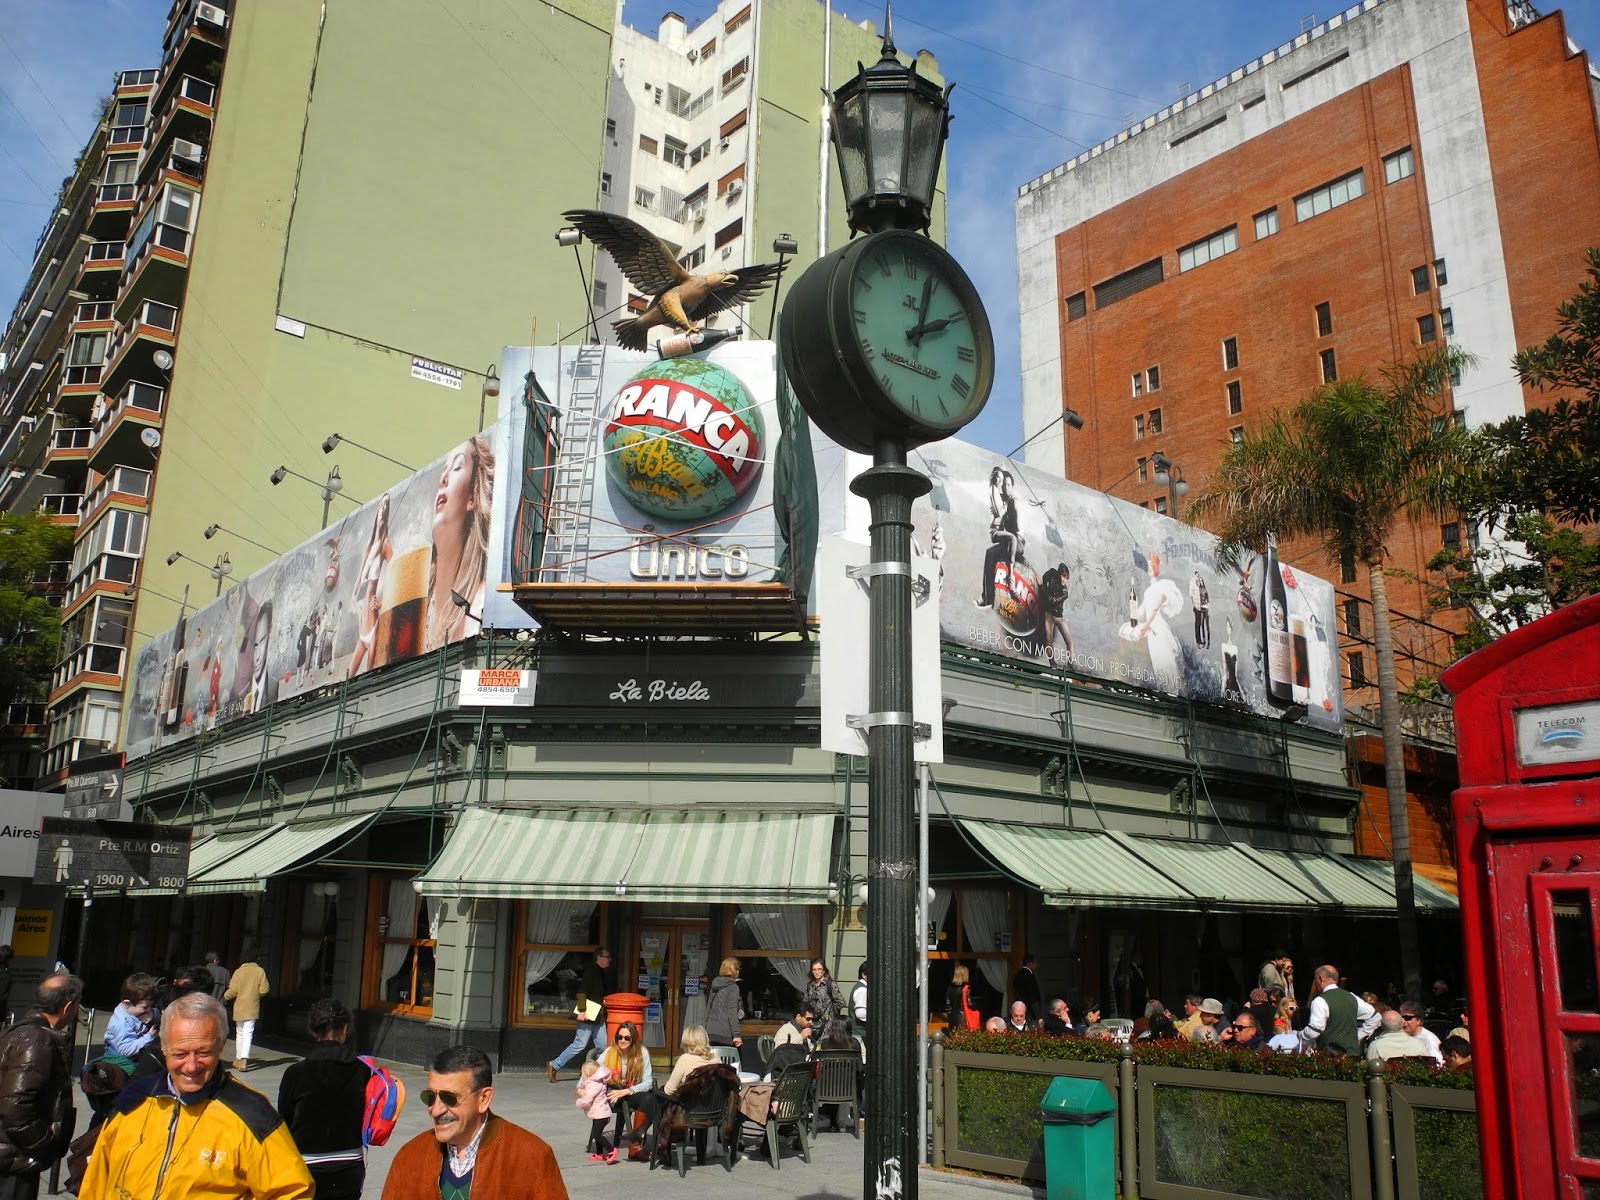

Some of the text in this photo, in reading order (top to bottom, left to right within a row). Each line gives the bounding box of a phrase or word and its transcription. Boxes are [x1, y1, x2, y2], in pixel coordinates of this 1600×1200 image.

[412, 357, 462, 379] PUBLICITAR
[968, 625, 1001, 648] BEBER
[1004, 635, 1032, 655] CON
[1109, 661, 1156, 685] PROHIBIDA
[1158, 669, 1169, 687] SU
[481, 670, 519, 678] MARCA
[479, 678, 519, 686] URBANA
[609, 679, 711, 703] La Biela
[1537, 716, 1586, 728] TELECOM
[1, 825, 41, 839] Aires
[150, 843, 179, 854] Ortiz
[96, 874, 124, 885] 1900
[158, 876, 184, 887] 1800
[15, 915, 48, 923] uenos
[18, 923, 46, 933] Aires
